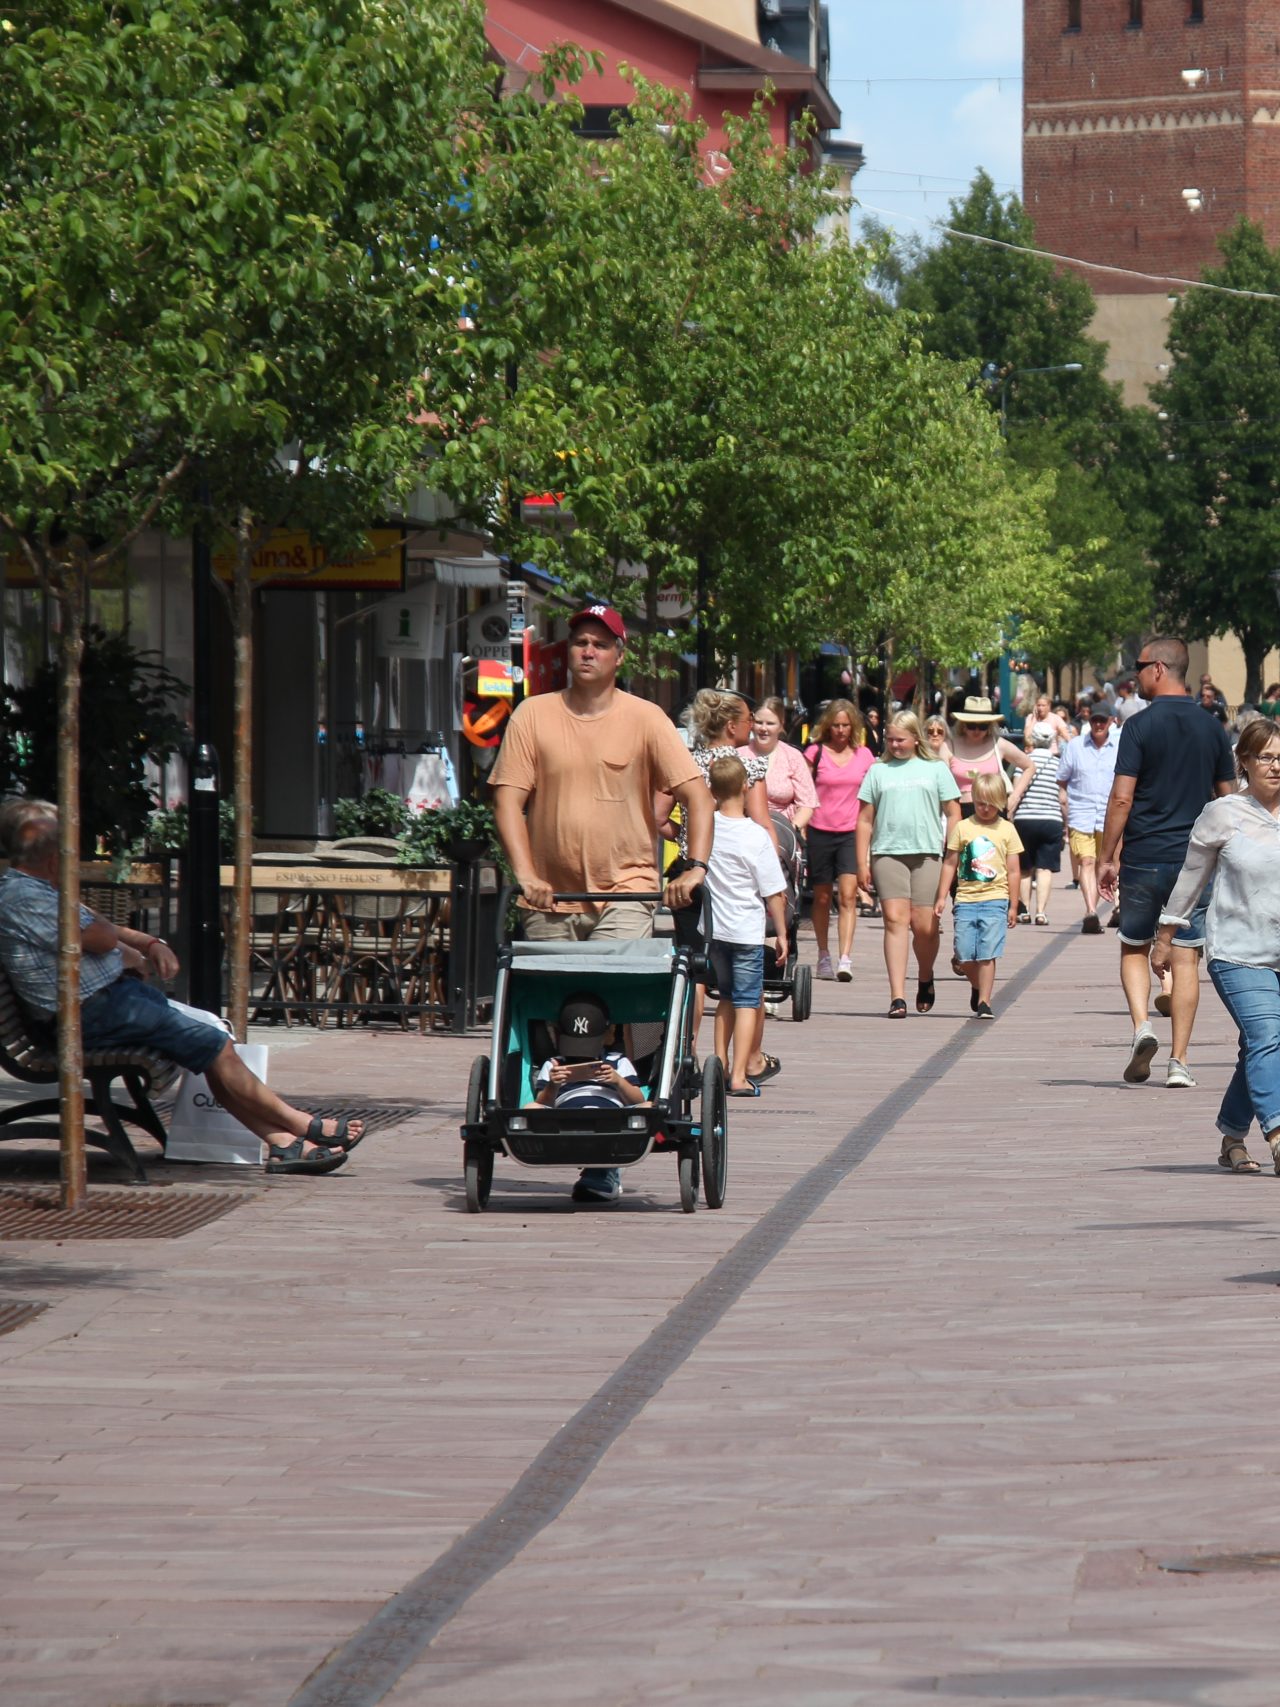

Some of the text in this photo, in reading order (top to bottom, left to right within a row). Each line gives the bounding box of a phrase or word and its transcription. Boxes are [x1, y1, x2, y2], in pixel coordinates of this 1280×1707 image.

[275, 872, 383, 883] ESPRESSO HOUSE
[573, 1016, 589, 1034] NY
